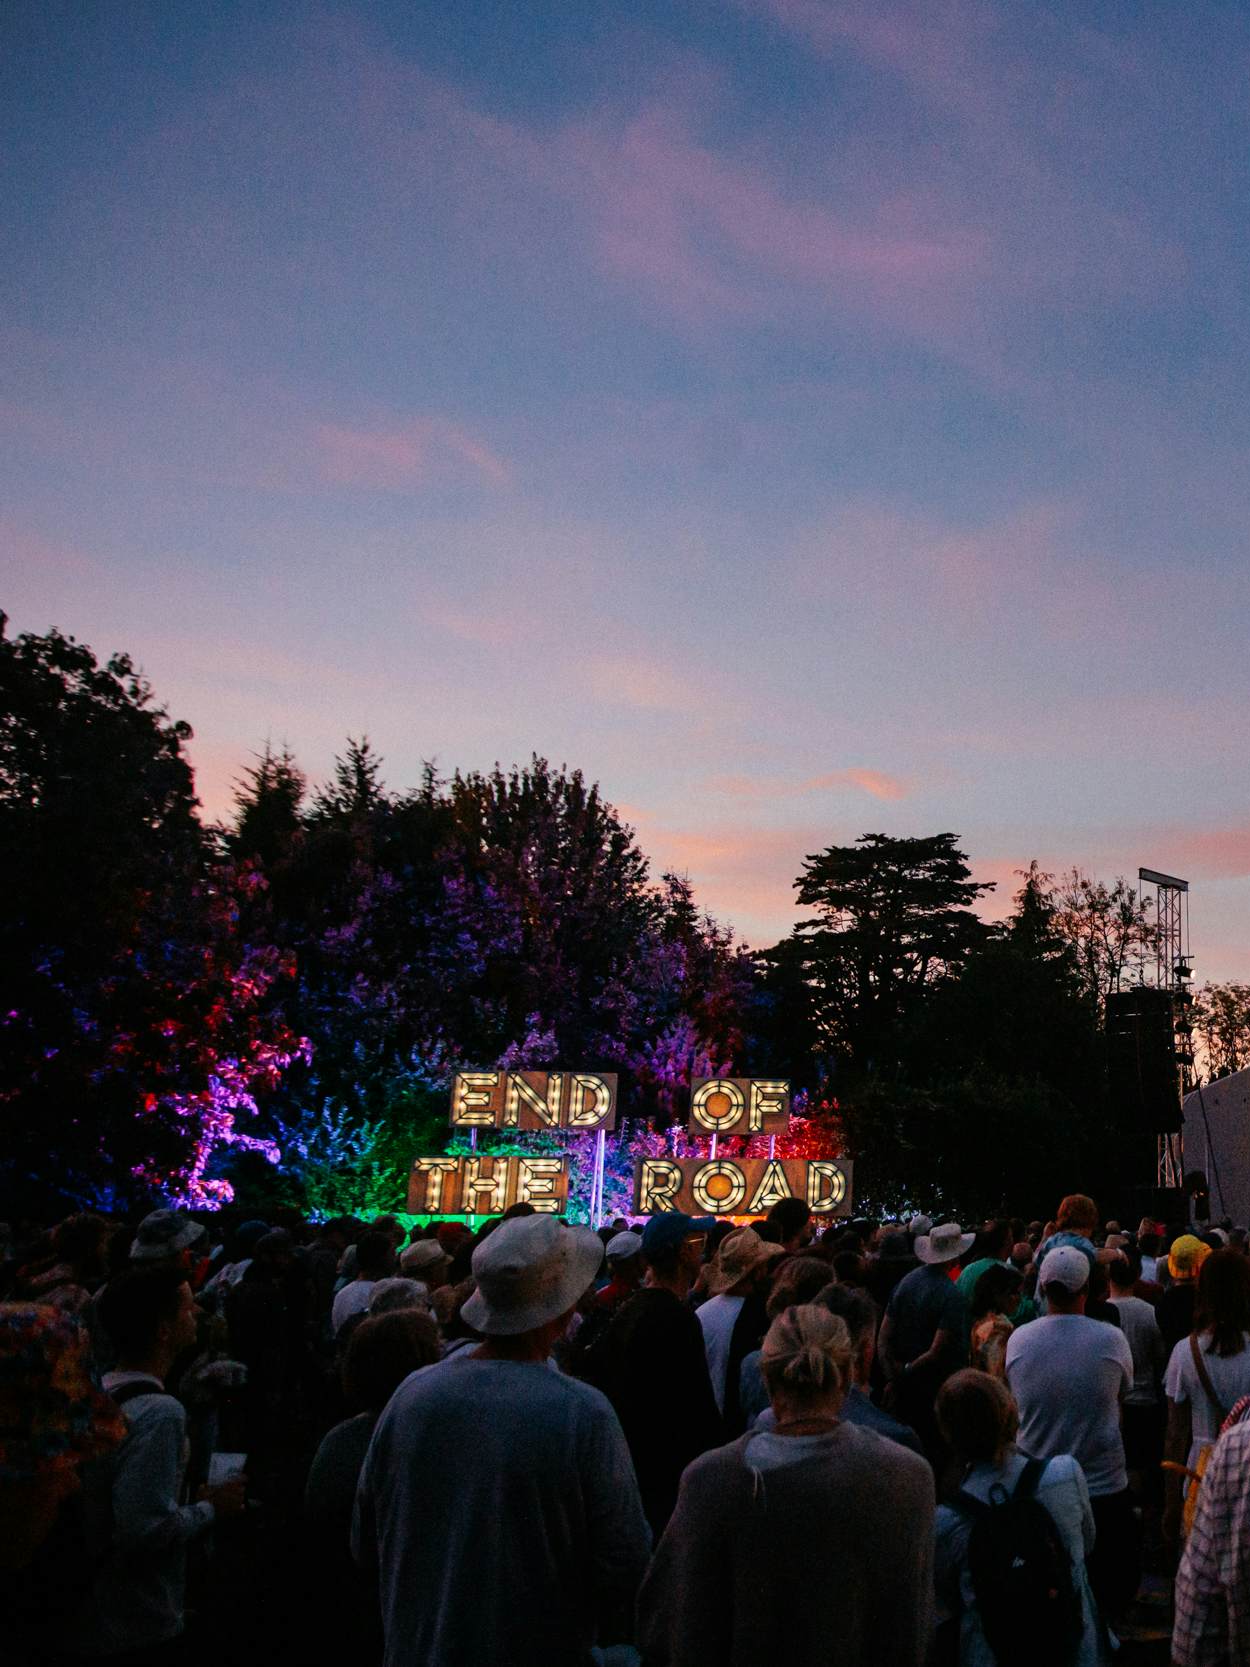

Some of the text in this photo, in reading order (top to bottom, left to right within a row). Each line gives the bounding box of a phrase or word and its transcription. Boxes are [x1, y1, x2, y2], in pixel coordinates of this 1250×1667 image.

[454, 1074, 790, 1132] END OF
[415, 1158, 847, 1213] THE ROAD
